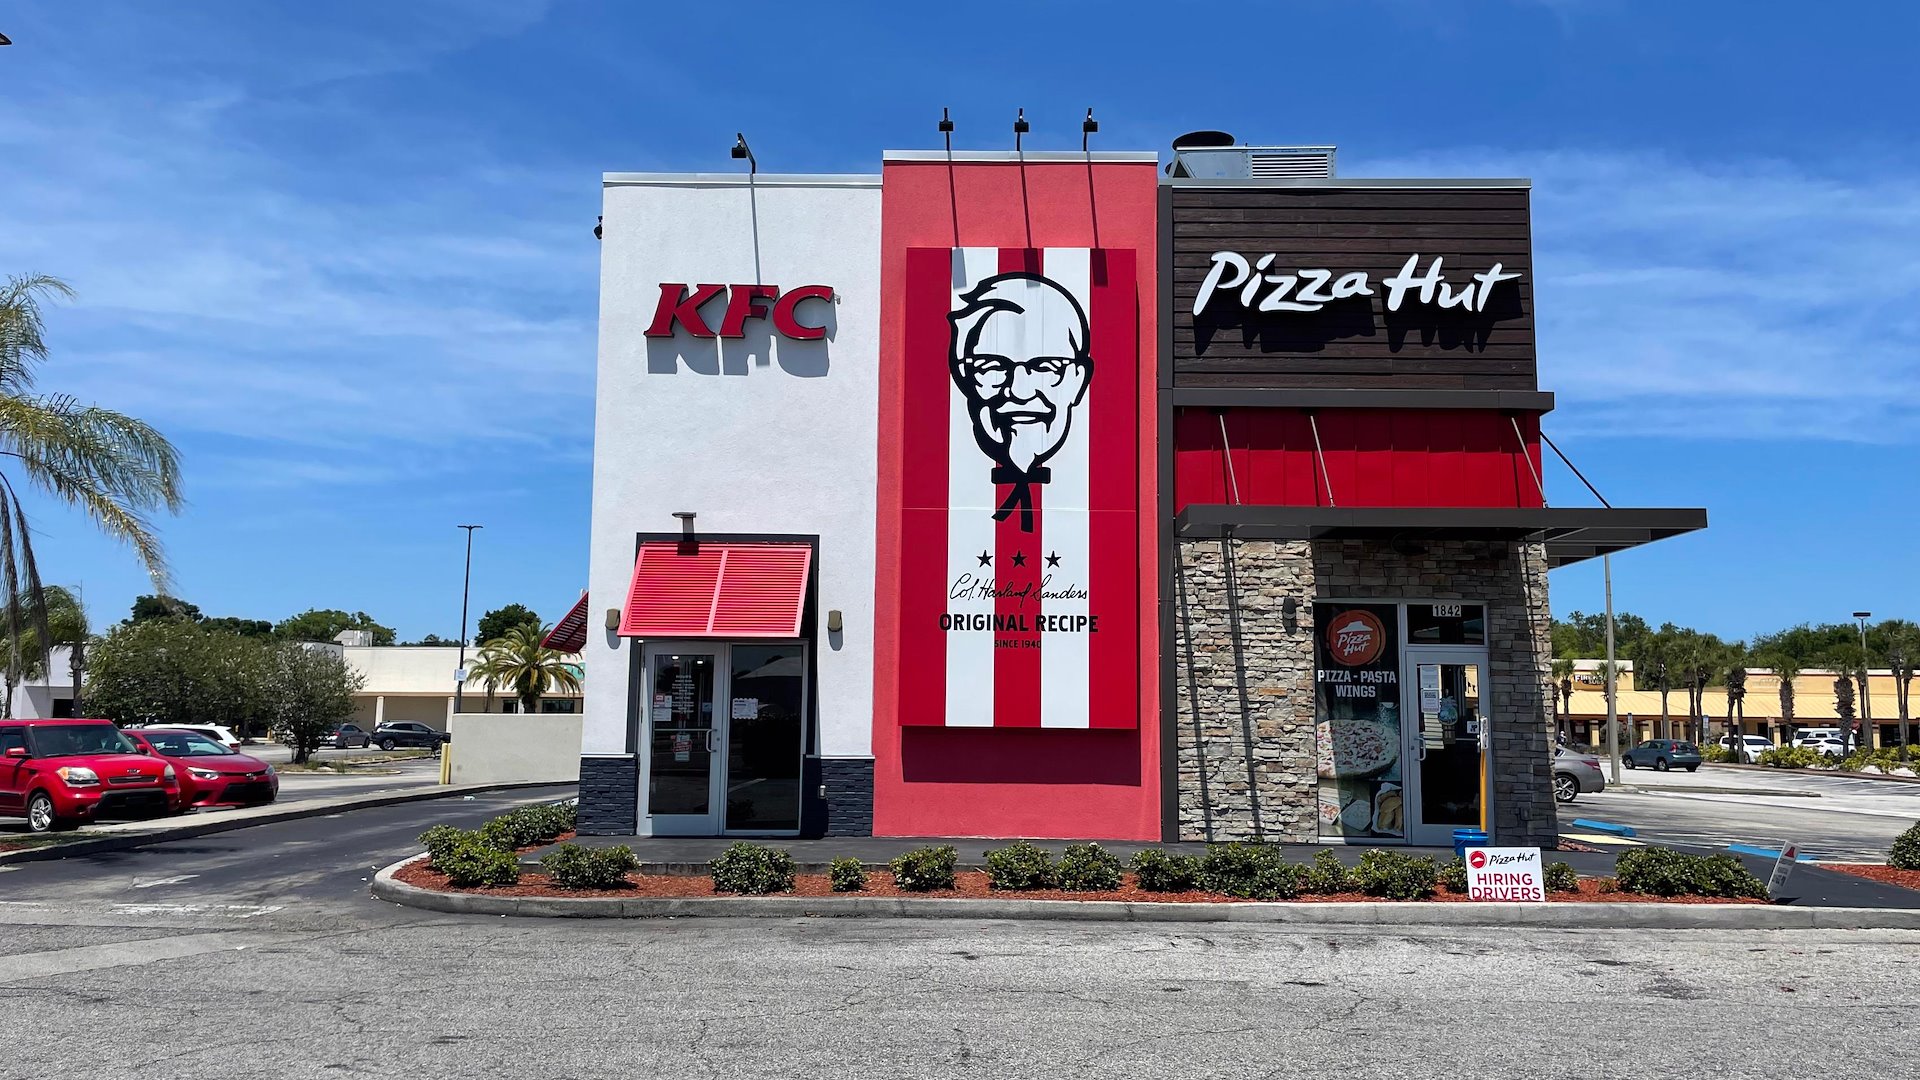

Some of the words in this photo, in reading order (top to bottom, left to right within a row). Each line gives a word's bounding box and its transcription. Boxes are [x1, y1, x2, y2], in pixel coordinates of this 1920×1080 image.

[1192, 251, 1374, 316] Pizza
[1382, 253, 1523, 312] Hut
[643, 283, 834, 340] KFC
[978, 578, 1032, 608] Harland
[1031, 573, 1087, 601] Sanders
[1434, 604, 1460, 616] 1842
[939, 613, 1028, 632] ORIGINAL
[1035, 615, 1098, 632] RECIPE
[994, 639, 1018, 648] SINCE
[1021, 639, 1042, 648] 1940
[1337, 632, 1371, 648] Pizza
[1344, 642, 1370, 657] Hut
[1317, 669, 1351, 682] PIZZA
[1360, 671, 1397, 683] PASTA
[1336, 685, 1376, 698] WINGS
[1489, 854, 1515, 866] Pizza
[1516, 852, 1537, 863] Hut
[1477, 873, 1533, 886] HIRING
[1471, 887, 1541, 900] DRIVERS
